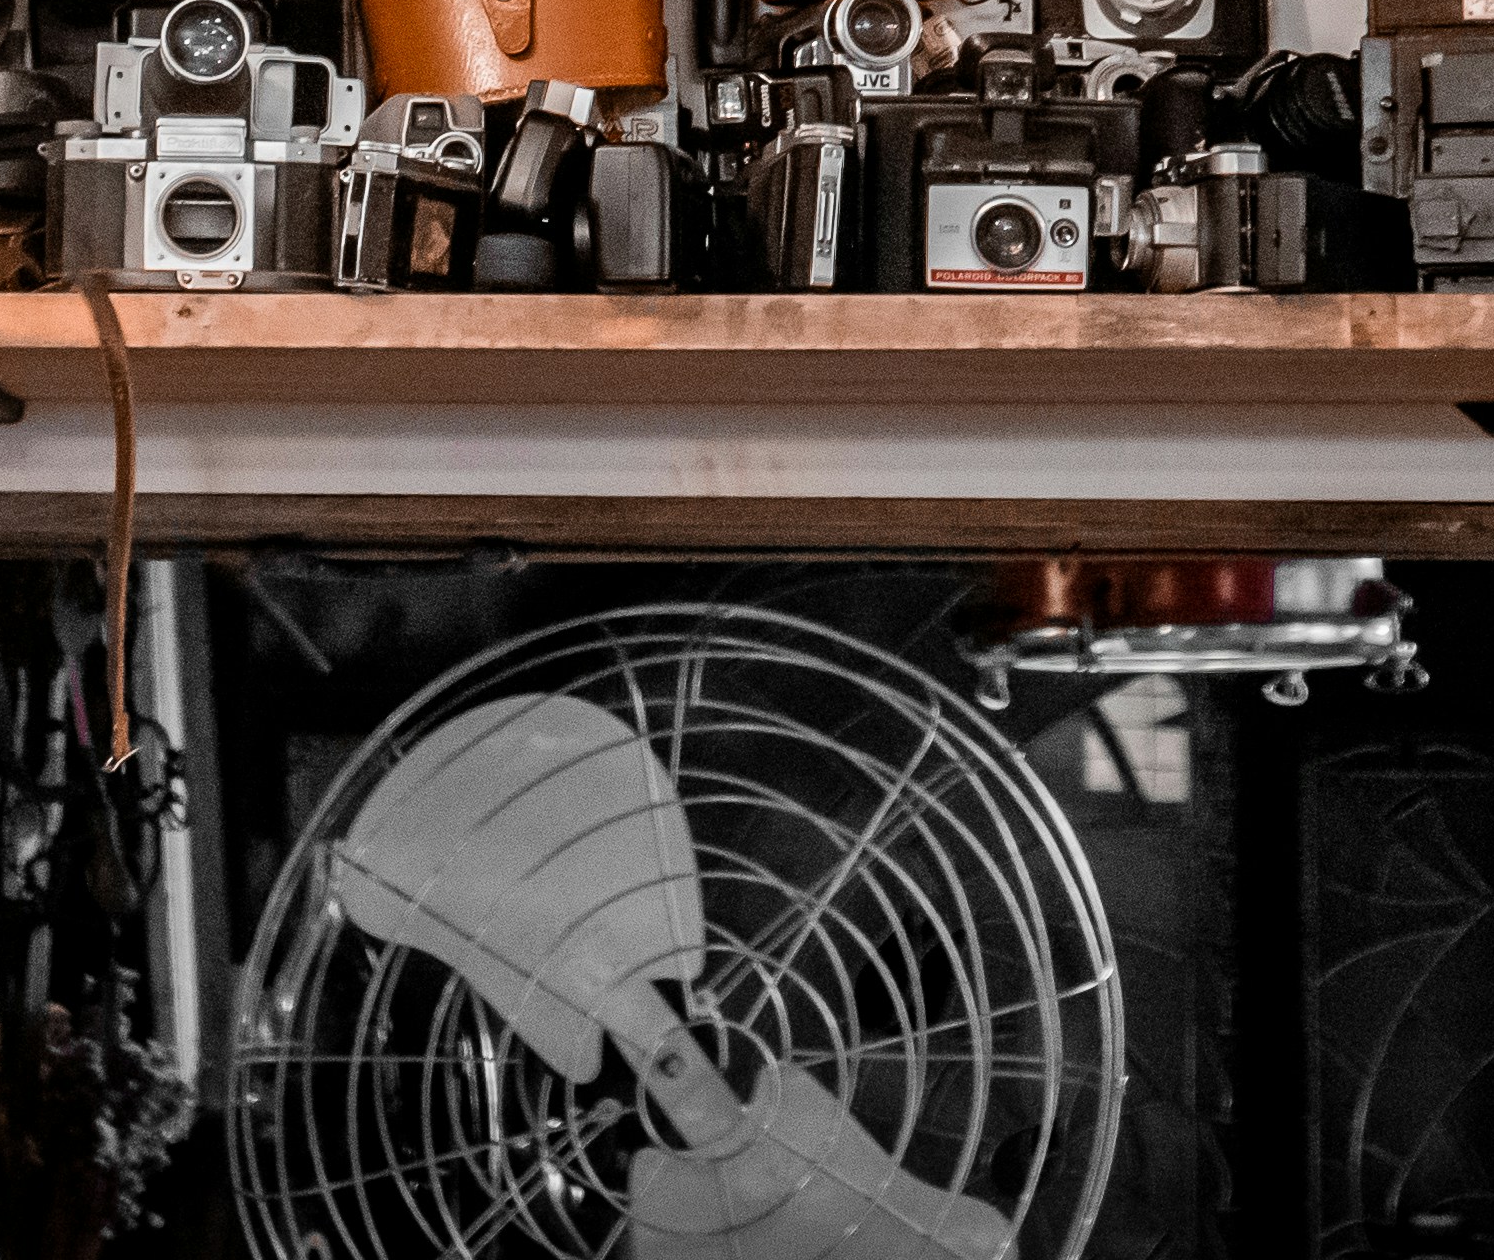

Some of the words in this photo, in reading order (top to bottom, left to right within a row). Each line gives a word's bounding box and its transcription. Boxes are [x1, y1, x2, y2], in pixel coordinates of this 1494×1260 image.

[857, 74, 890, 87] JVC
[761, 84, 772, 128] Canon
[935, 271, 991, 281] POLAROID
